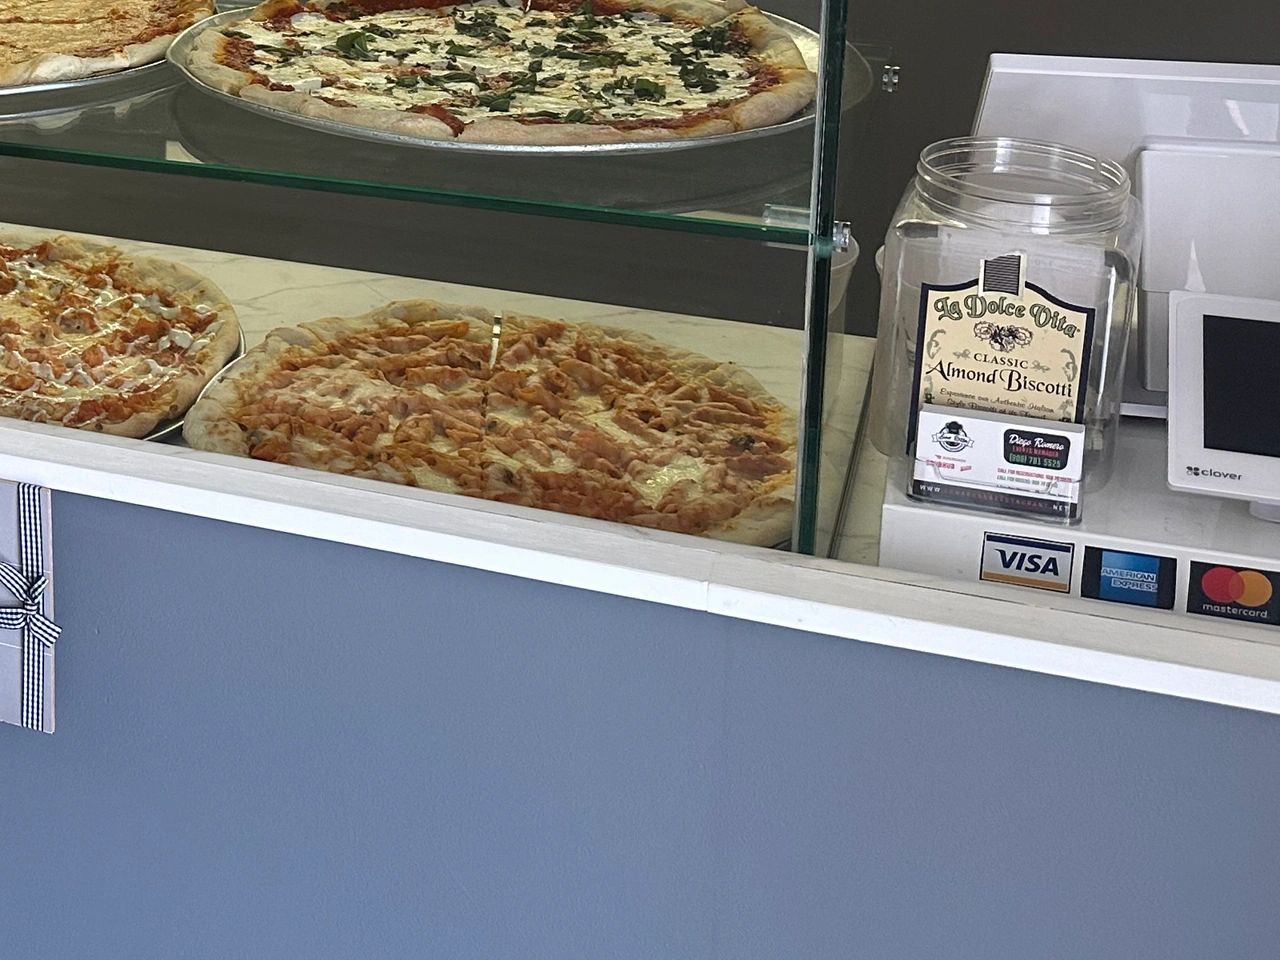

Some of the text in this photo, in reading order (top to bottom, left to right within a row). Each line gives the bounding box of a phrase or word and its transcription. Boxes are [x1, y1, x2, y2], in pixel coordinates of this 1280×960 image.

[934, 294, 1077, 338] La Dolce Vita
[973, 352, 1029, 370] CLASSIC
[926, 360, 1072, 398] Almond Biscotti
[1008, 434, 1064, 450] Diego Romero
[1201, 468, 1242, 481] clover
[994, 548, 1059, 576] VISA
[1101, 568, 1156, 582] AMERICAN
[1112, 578, 1158, 592] EXPRESS
[1202, 603, 1268, 619] mastercard
